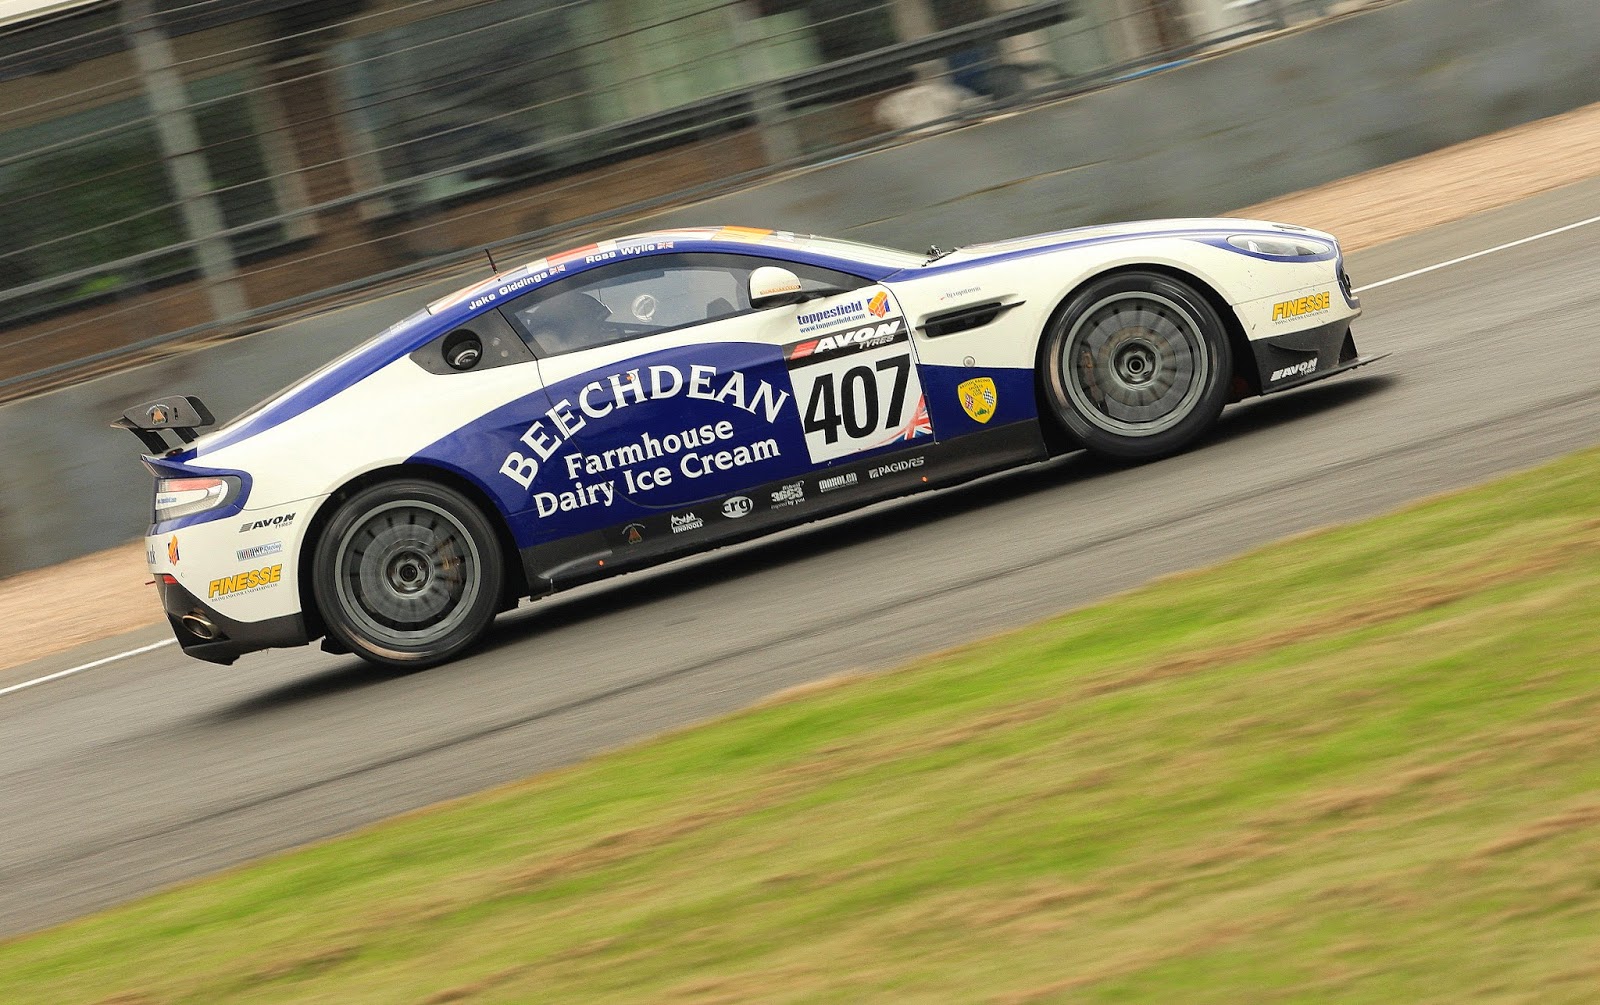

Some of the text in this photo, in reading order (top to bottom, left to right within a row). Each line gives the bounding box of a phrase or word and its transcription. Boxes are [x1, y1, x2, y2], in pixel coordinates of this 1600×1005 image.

[585, 243, 655, 264] Ross Wylie
[468, 273, 548, 311] Jake Giddings
[1271, 291, 1330, 322] FINESSE
[796, 300, 863, 326] toppesfield
[814, 320, 901, 354] AVON
[859, 334, 895, 350] TYRES
[1281, 357, 1318, 379] AVON
[803, 353, 911, 446] 407
[499, 364, 791, 491] BEECHDEAN
[563, 420, 735, 481] Farmhouse
[533, 437, 782, 520] Dairy Ice Cream
[770, 486, 804, 503] 3663
[251, 512, 297, 530] AVON
[207, 563, 283, 599] FINESSE
